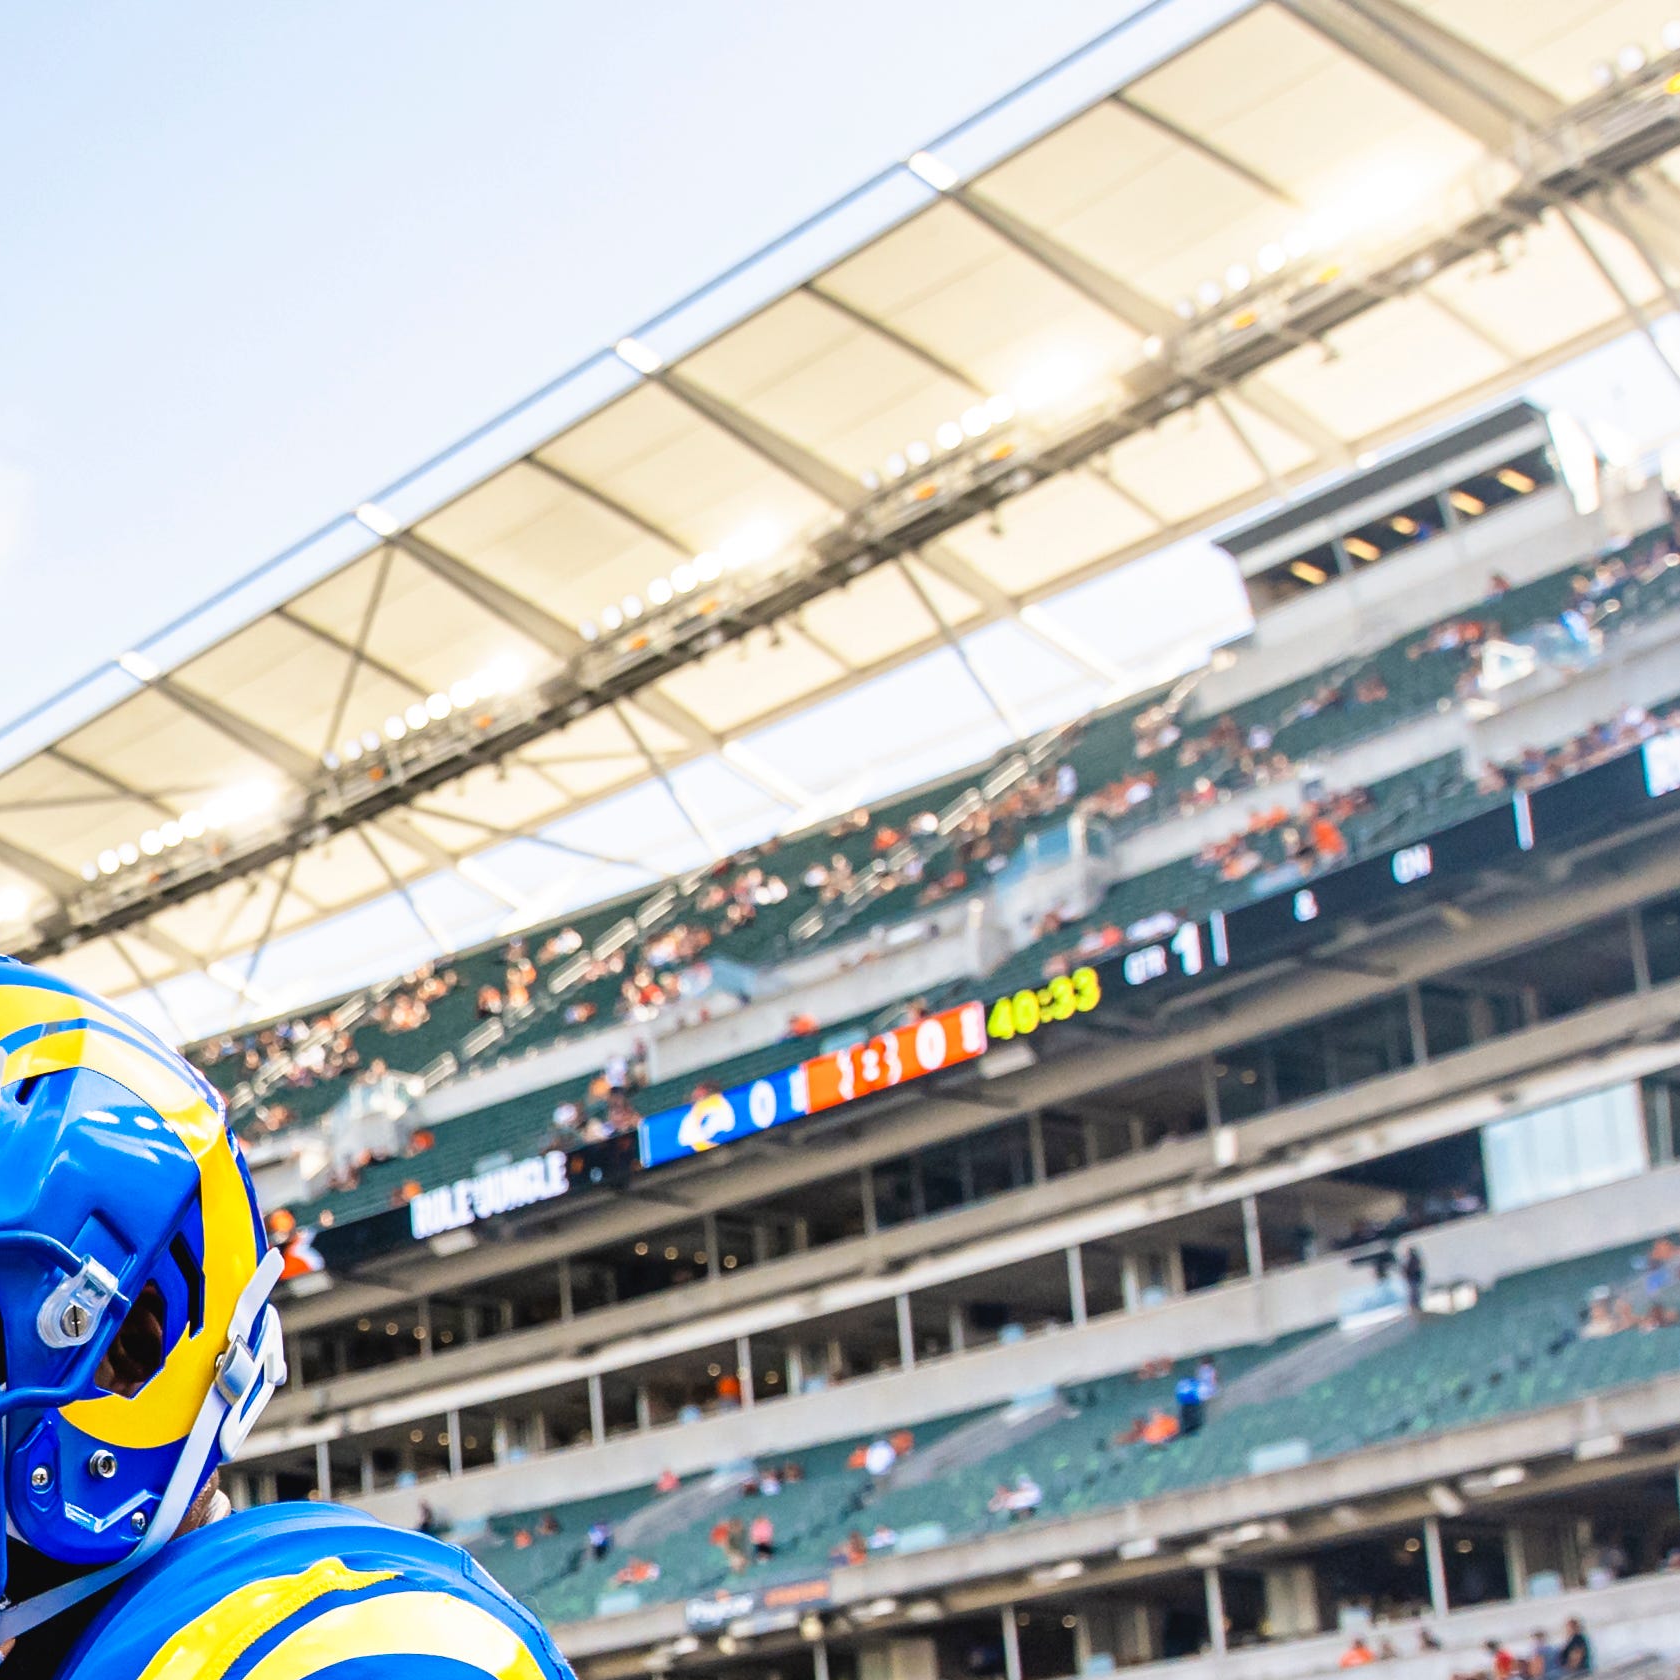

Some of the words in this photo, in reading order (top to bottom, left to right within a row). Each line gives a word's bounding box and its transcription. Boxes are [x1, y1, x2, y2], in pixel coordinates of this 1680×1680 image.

[1171, 921, 1203, 976] 1
[987, 966, 1102, 1040] 40:33
[749, 1080, 776, 1128] 0
